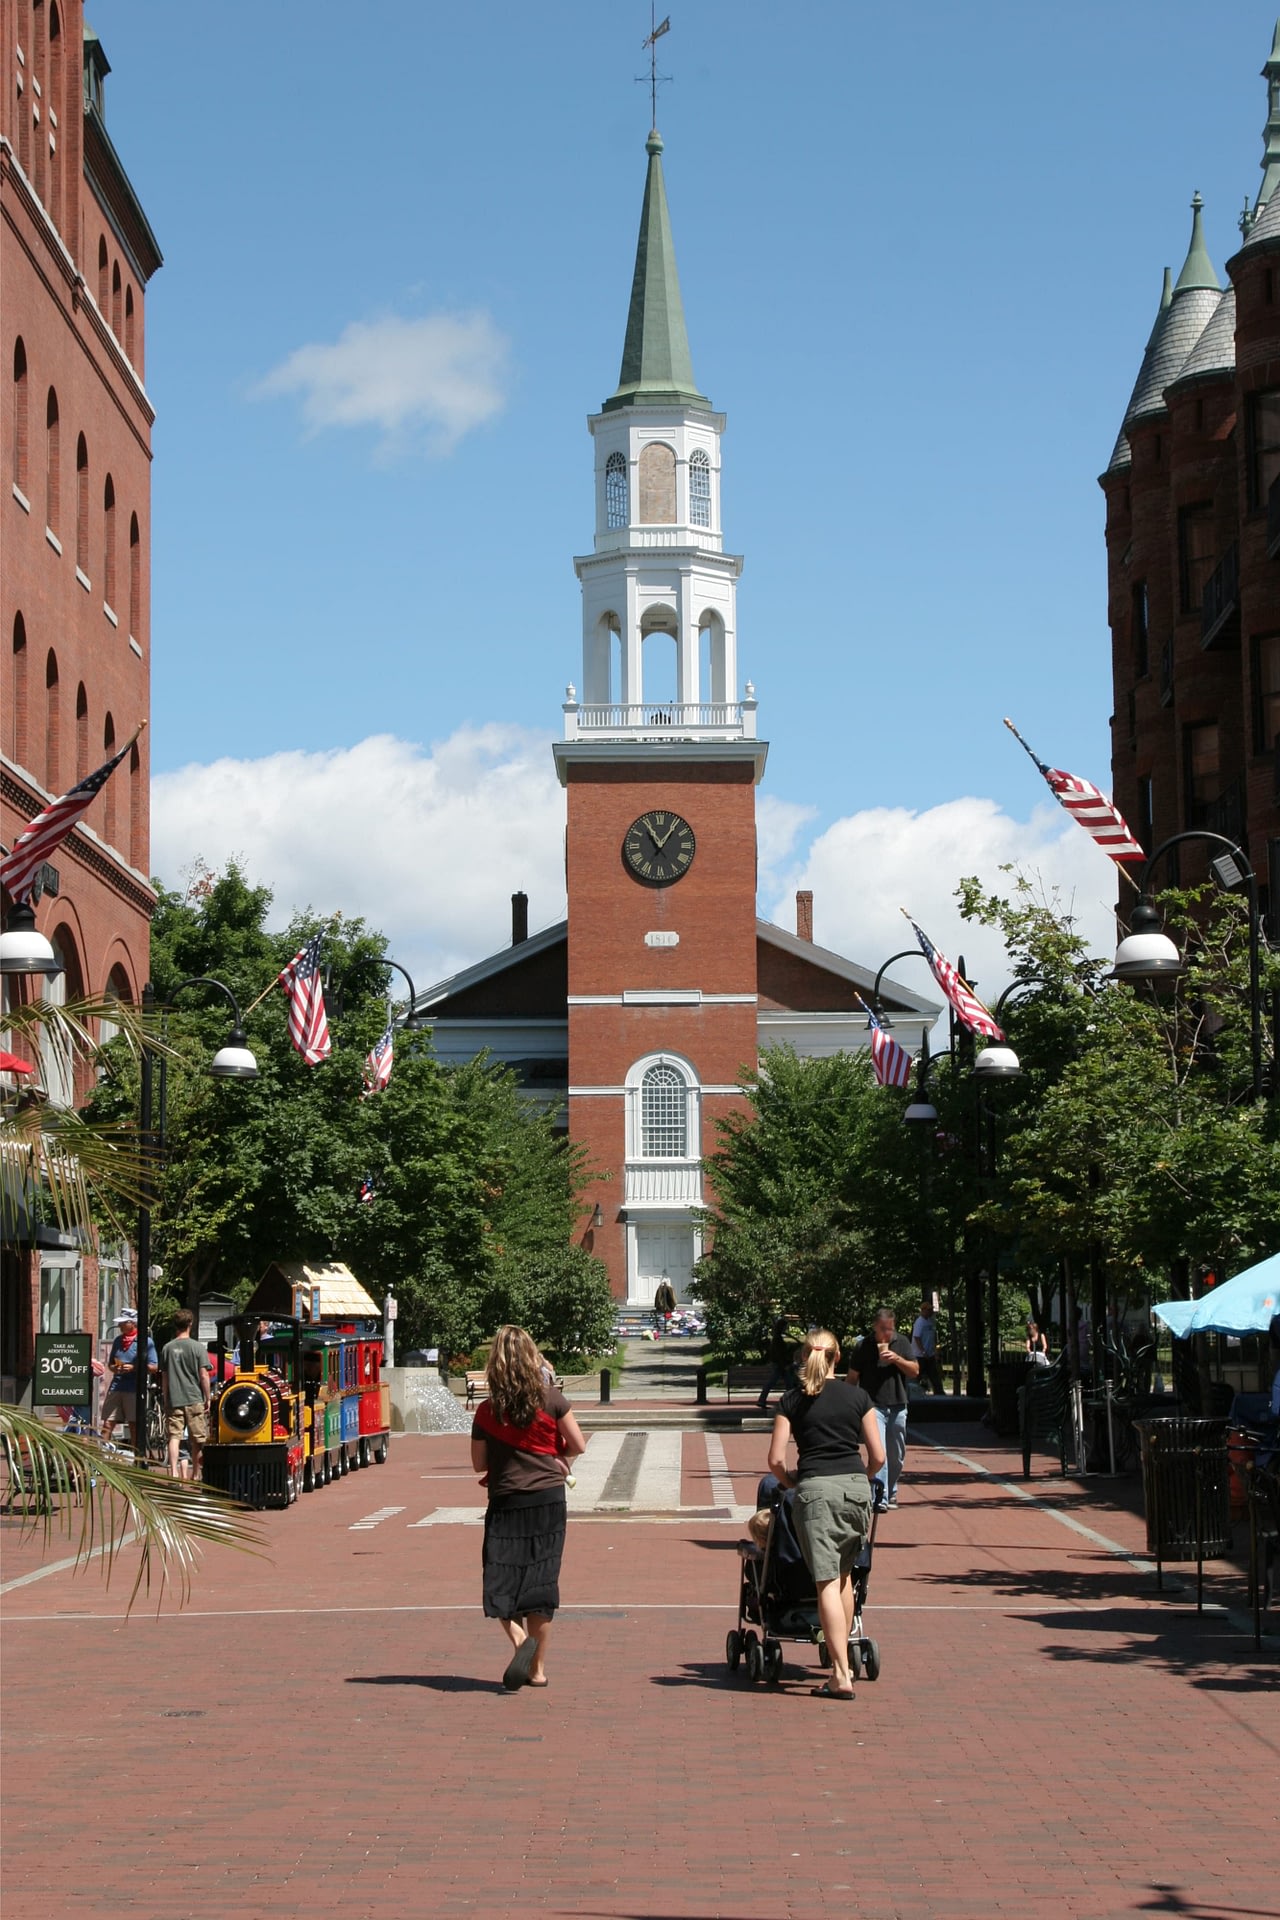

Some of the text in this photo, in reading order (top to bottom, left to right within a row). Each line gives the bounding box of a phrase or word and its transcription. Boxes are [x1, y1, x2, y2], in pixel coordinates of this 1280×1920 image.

[40, 1356, 88, 1374] 30% OFF
[41, 1388, 84, 1396] CLEARANCE
